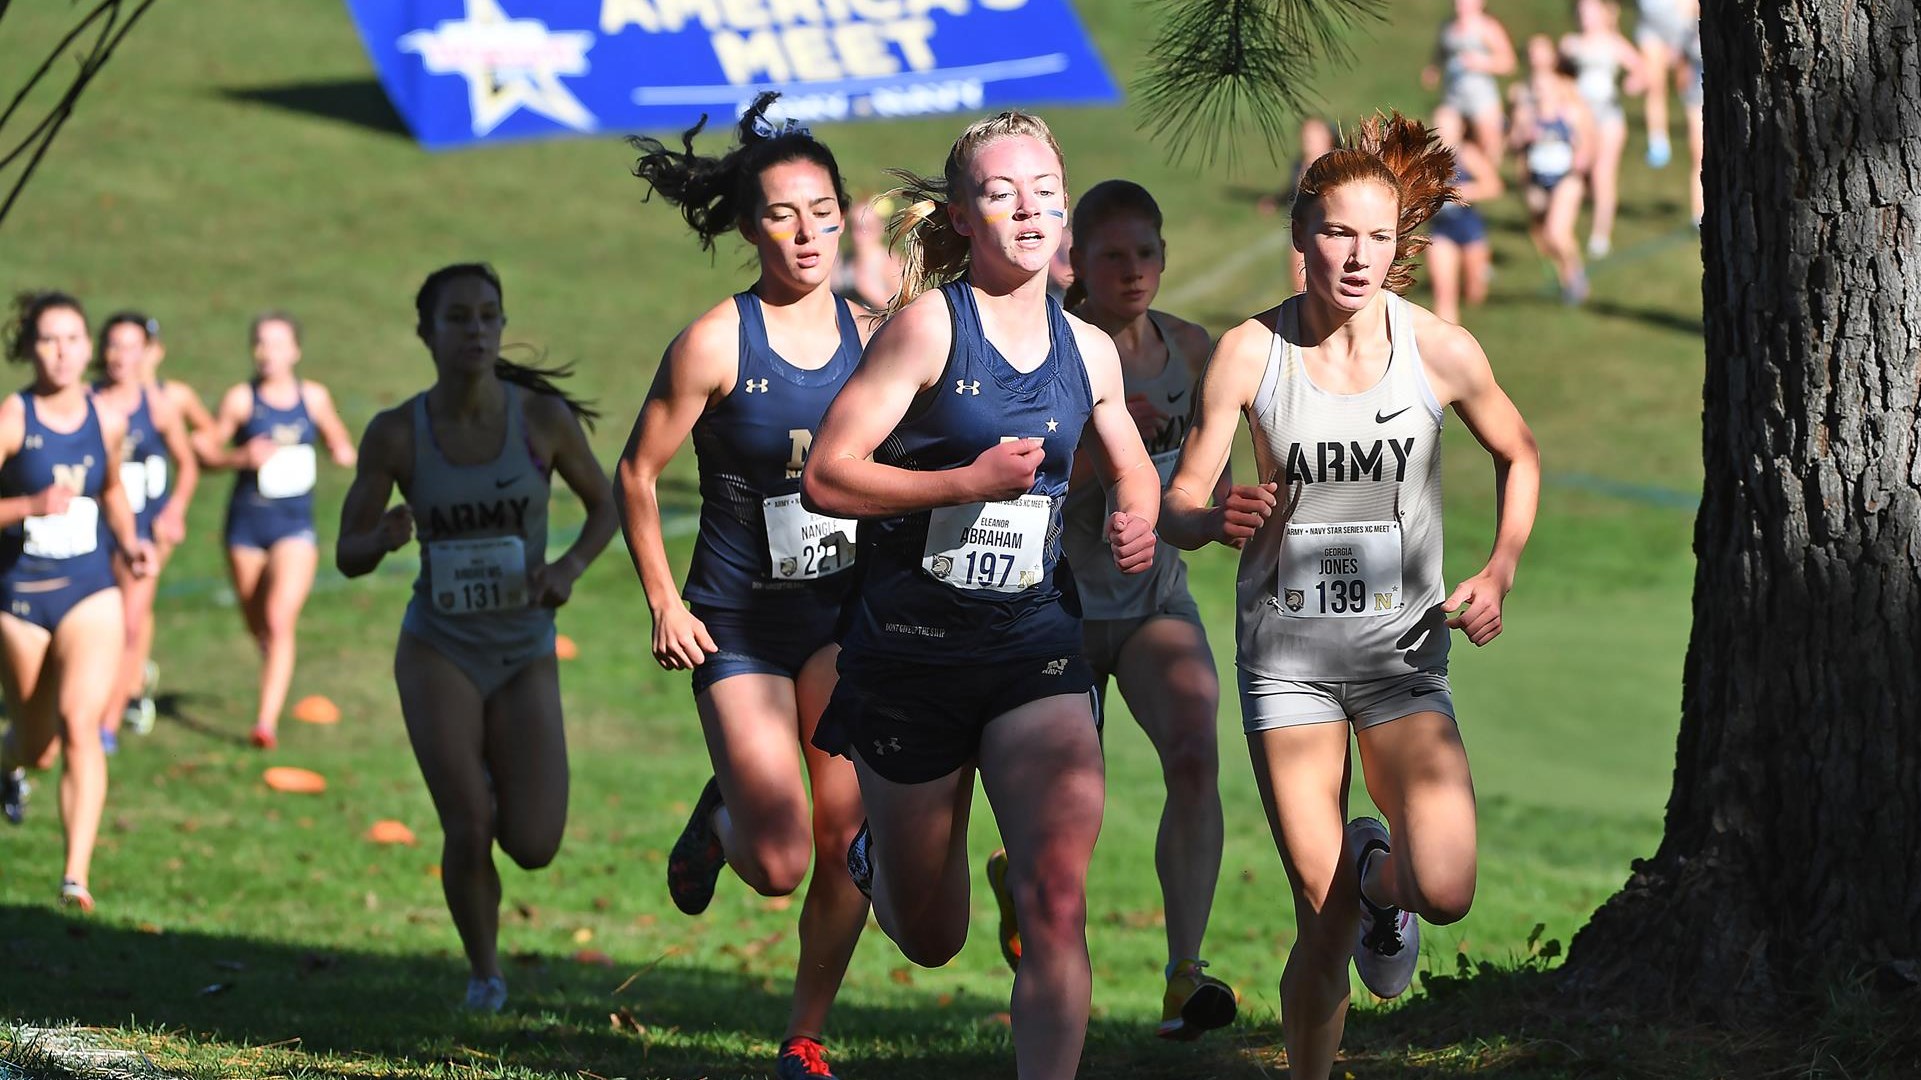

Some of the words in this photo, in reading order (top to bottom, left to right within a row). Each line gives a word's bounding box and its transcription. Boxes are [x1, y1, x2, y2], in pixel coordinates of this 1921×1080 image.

[711, 16, 936, 84] MEET
[1286, 438, 1415, 484] ARMY
[430, 497, 529, 534] ARMY
[981, 517, 1010, 528] ELEANOR
[960, 526, 1023, 549] ABRAHAM
[1310, 527, 1326, 535] NAVY
[1327, 526, 1343, 534] STAR
[1343, 525, 1364, 534] SERIES
[1364, 525, 1373, 533] XC
[1373, 525, 1390, 533] MEET
[1324, 547, 1352, 557] GEORGIA
[966, 551, 1015, 588] 197
[1319, 558, 1358, 575] JONES
[462, 582, 500, 609] 131
[1316, 579, 1366, 614] 139
[1374, 593, 1393, 611] N
